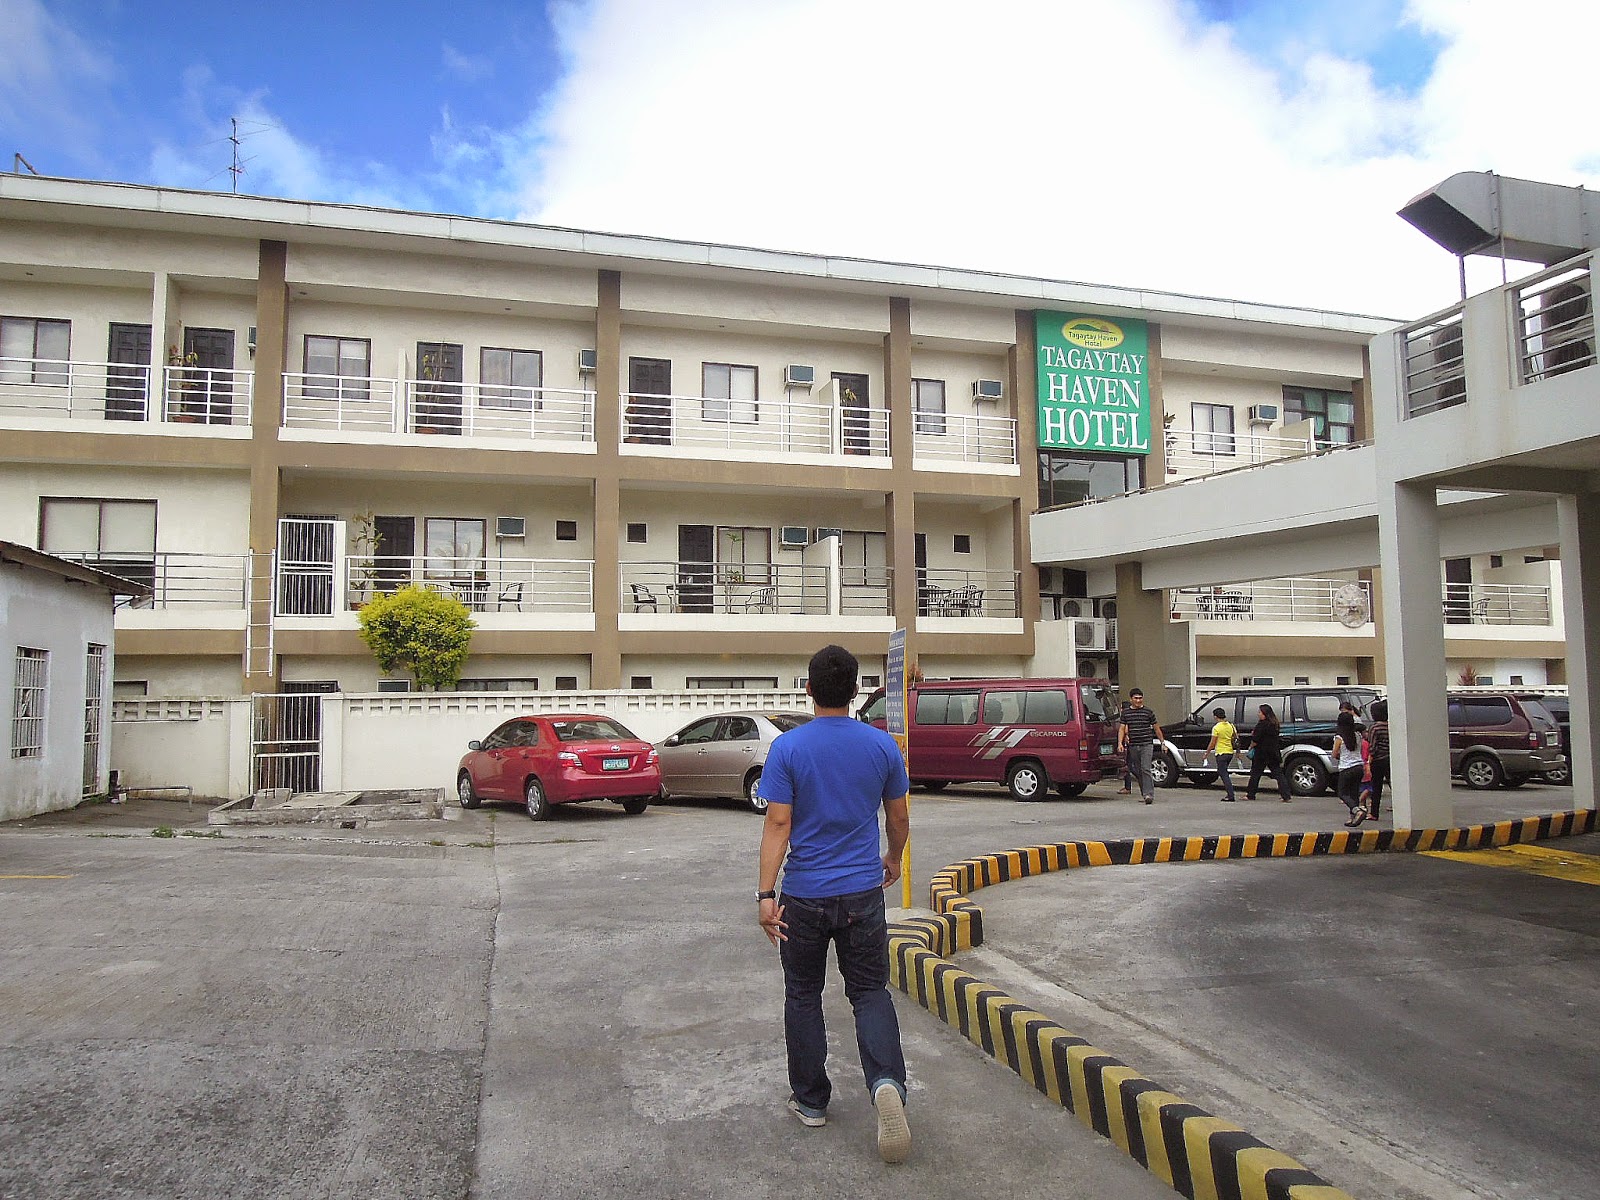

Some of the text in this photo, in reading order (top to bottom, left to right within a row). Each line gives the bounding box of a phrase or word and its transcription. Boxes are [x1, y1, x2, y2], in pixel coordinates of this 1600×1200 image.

[1069, 331, 1118, 342] Tagaytay Haven
[1041, 345, 1145, 375] TAGAYTAY
[1047, 372, 1141, 409] HAVEN
[1042, 407, 1148, 450] HOTEL
